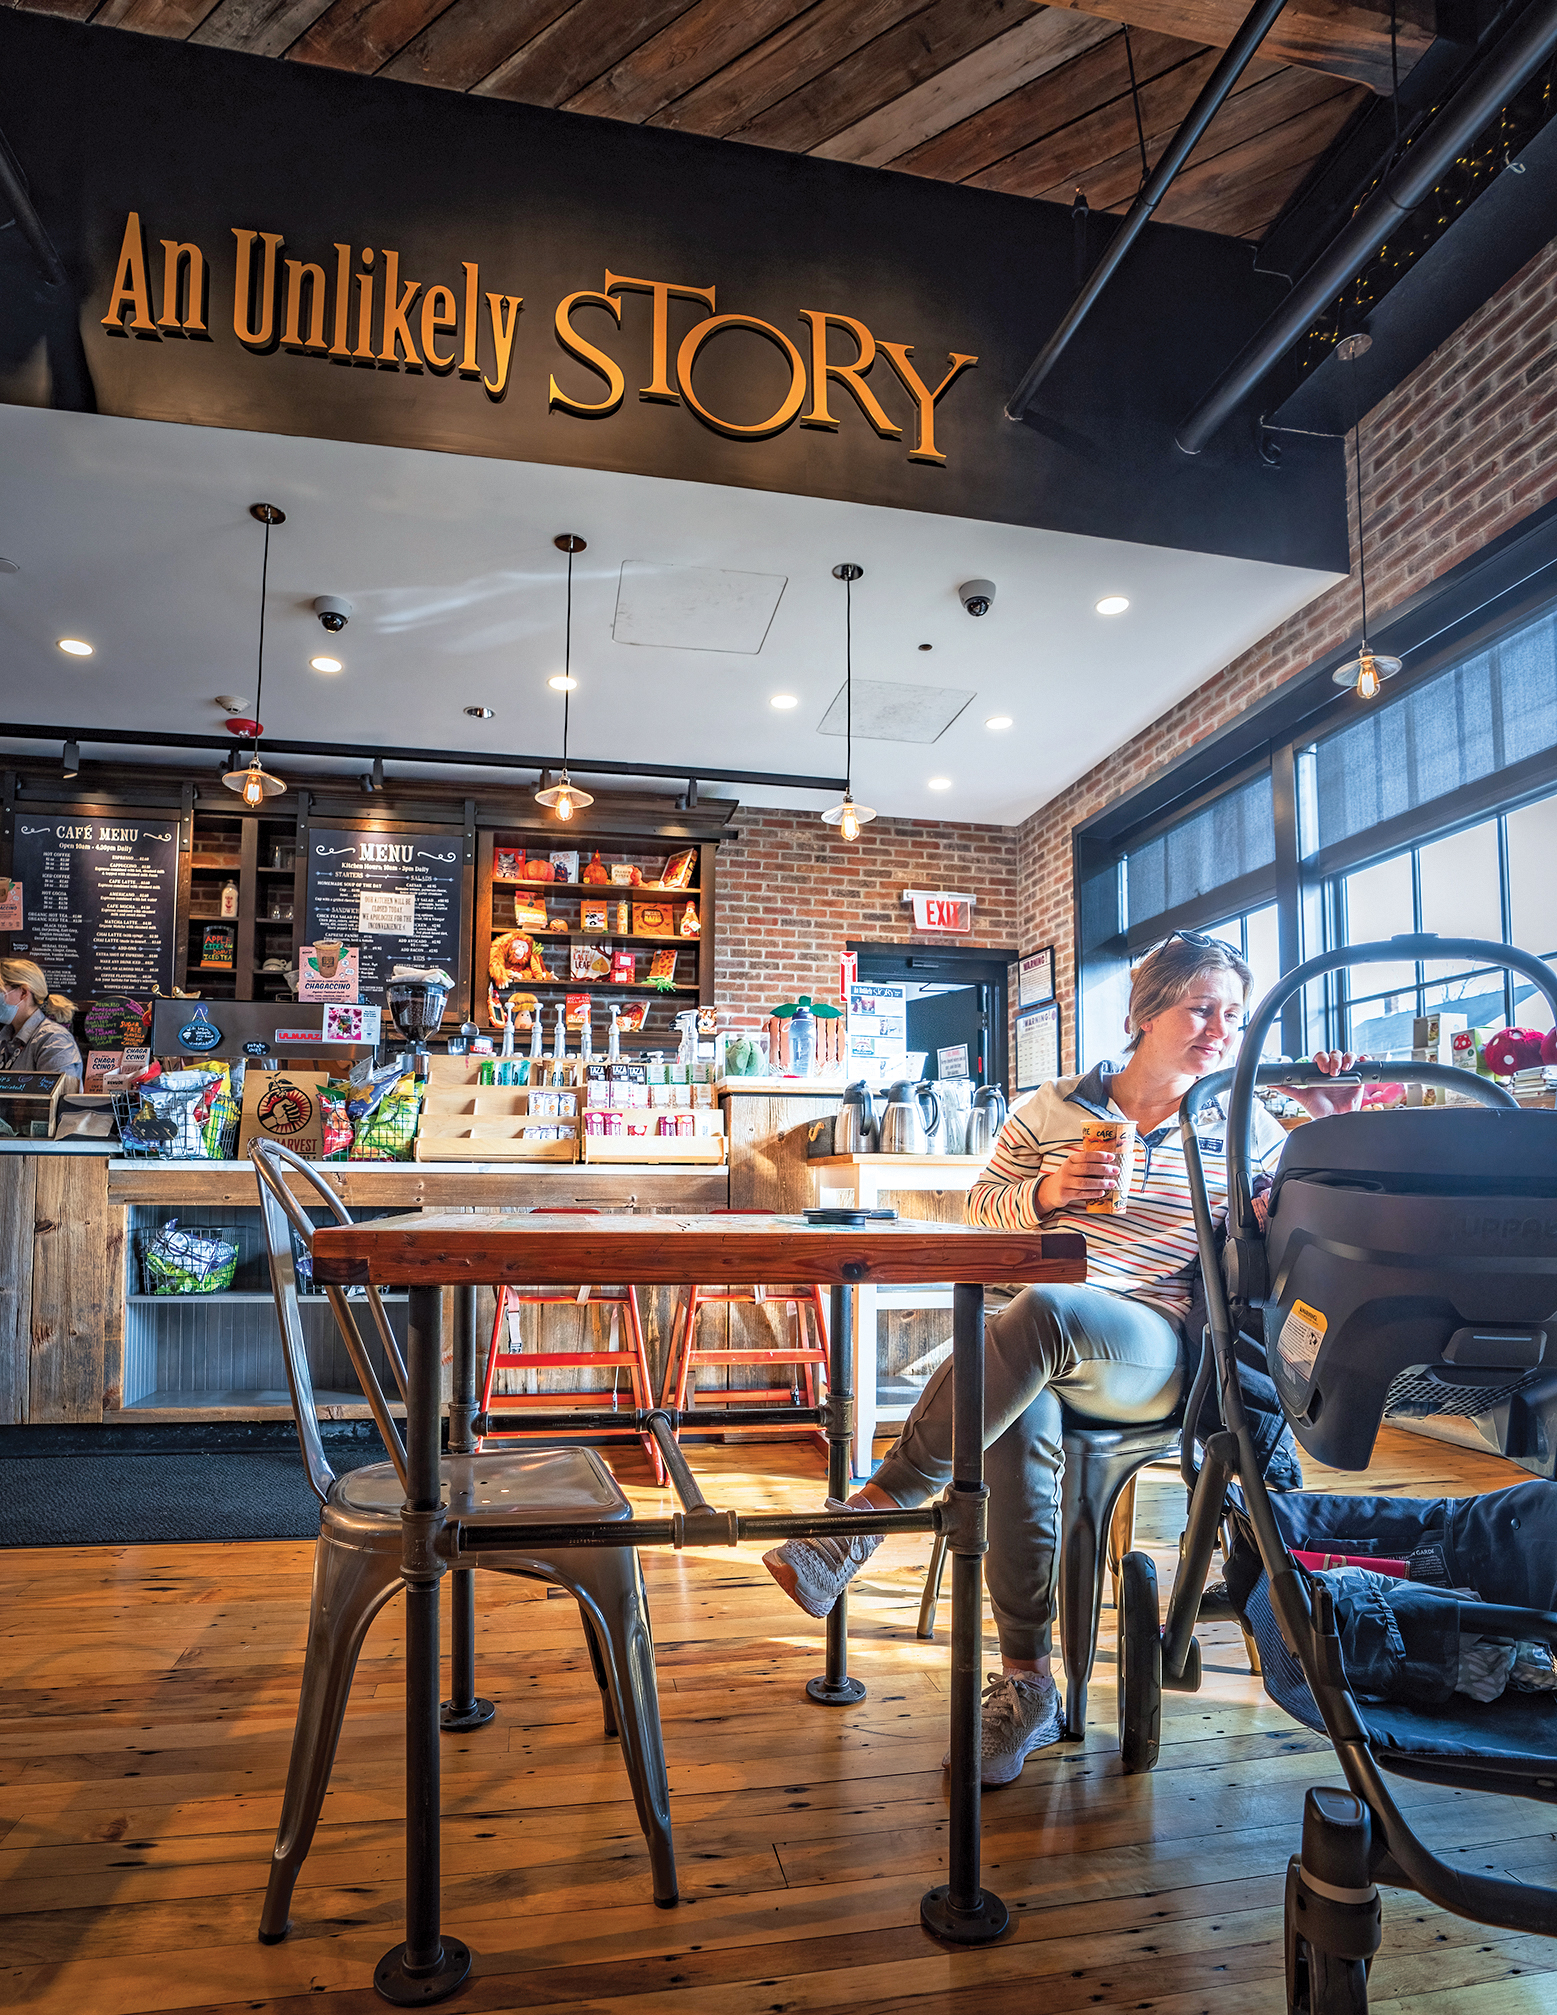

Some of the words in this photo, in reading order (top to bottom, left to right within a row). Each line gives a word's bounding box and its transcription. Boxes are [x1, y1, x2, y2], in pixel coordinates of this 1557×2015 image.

[101, 211, 210, 333] An
[231, 228, 523, 398] Unlikely
[549, 268, 978, 463] STORY
[56, 824, 92, 840] CAFÉ
[99, 828, 139, 842] MENU
[117, 845, 132, 854] Daily
[359, 843, 414, 862] MENU
[415, 866, 429, 874] Daily
[926, 900, 961, 927] EXIT
[205, 936, 232, 944] APPLE
[575, 960, 590, 969] LEAF
[590, 1066, 604, 1075] TAZA
[612, 1066, 627, 1075] TAZA
[628, 1067, 644, 1076] TAZA
[1096, 1130, 1114, 1138] CAFE
[275, 1138, 318, 1152] ARVEST
